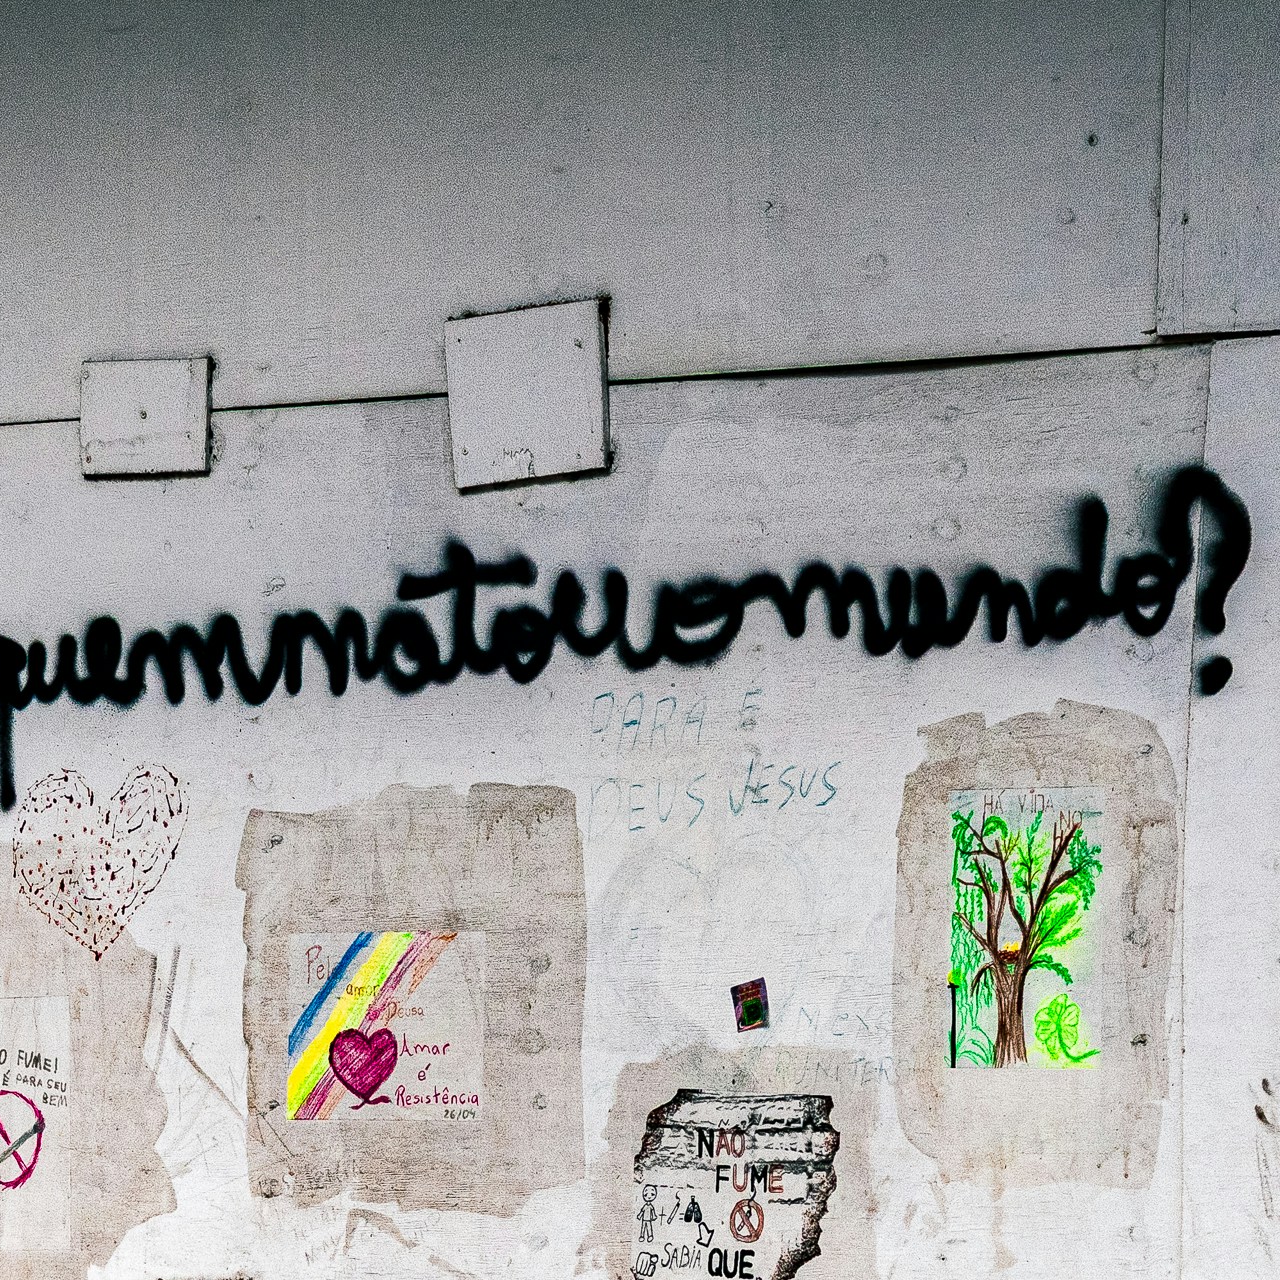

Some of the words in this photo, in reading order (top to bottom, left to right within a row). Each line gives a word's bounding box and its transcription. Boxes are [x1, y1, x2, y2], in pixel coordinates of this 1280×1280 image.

[305, 944, 334, 984] Pel
[400, 1033, 450, 1057] Amar
[46, 1079, 67, 1093] SEU
[394, 1084, 480, 1107] Resistência
[42, 1092, 68, 1107] BEM
[715, 1163, 785, 1194] FUME
